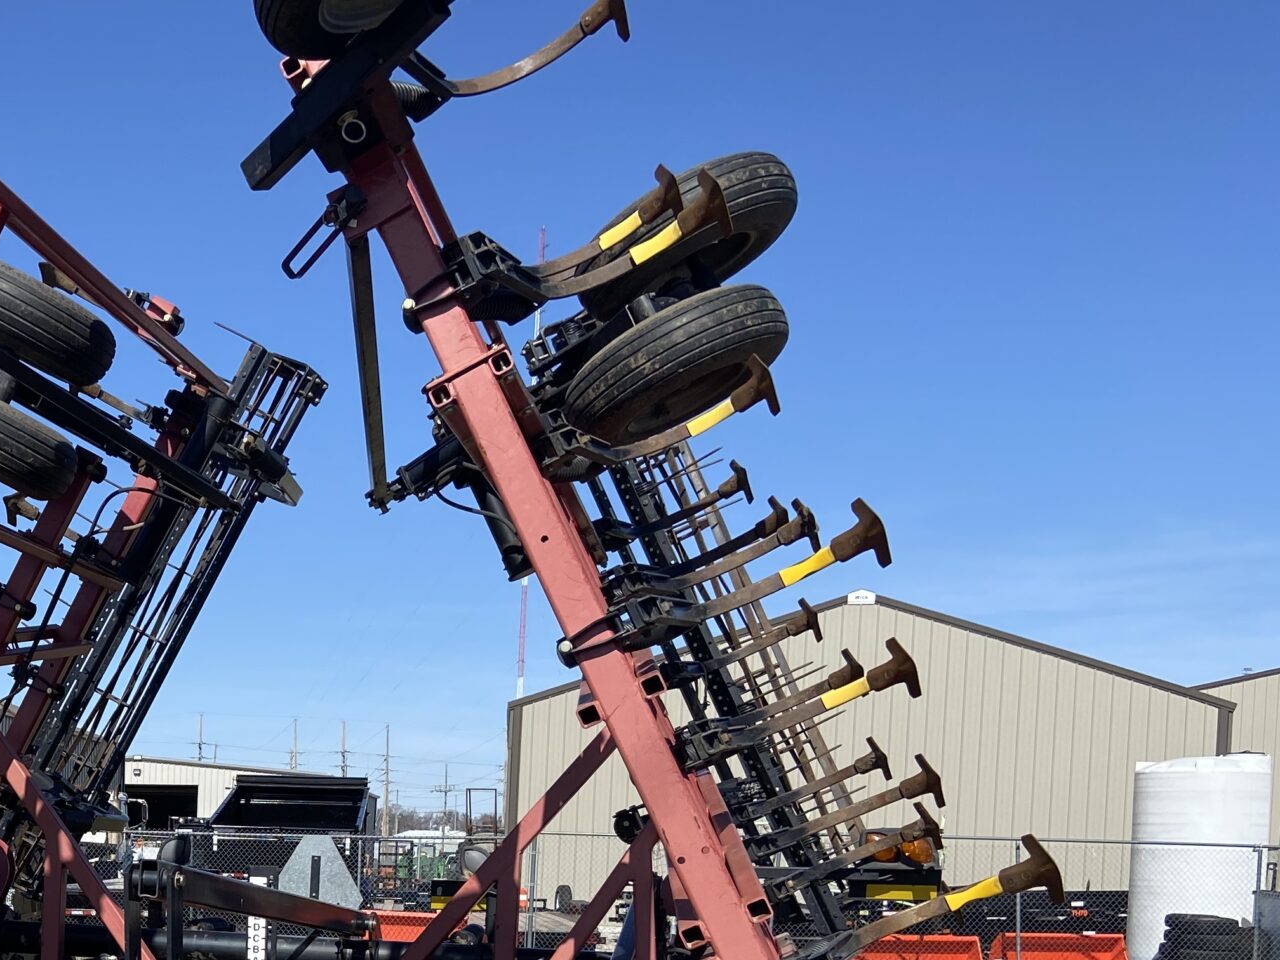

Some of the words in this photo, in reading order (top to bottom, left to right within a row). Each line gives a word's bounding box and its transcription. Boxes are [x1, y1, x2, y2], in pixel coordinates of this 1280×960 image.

[253, 923, 260, 931] D
[253, 934, 260, 942] C
[252, 945, 260, 953] B
